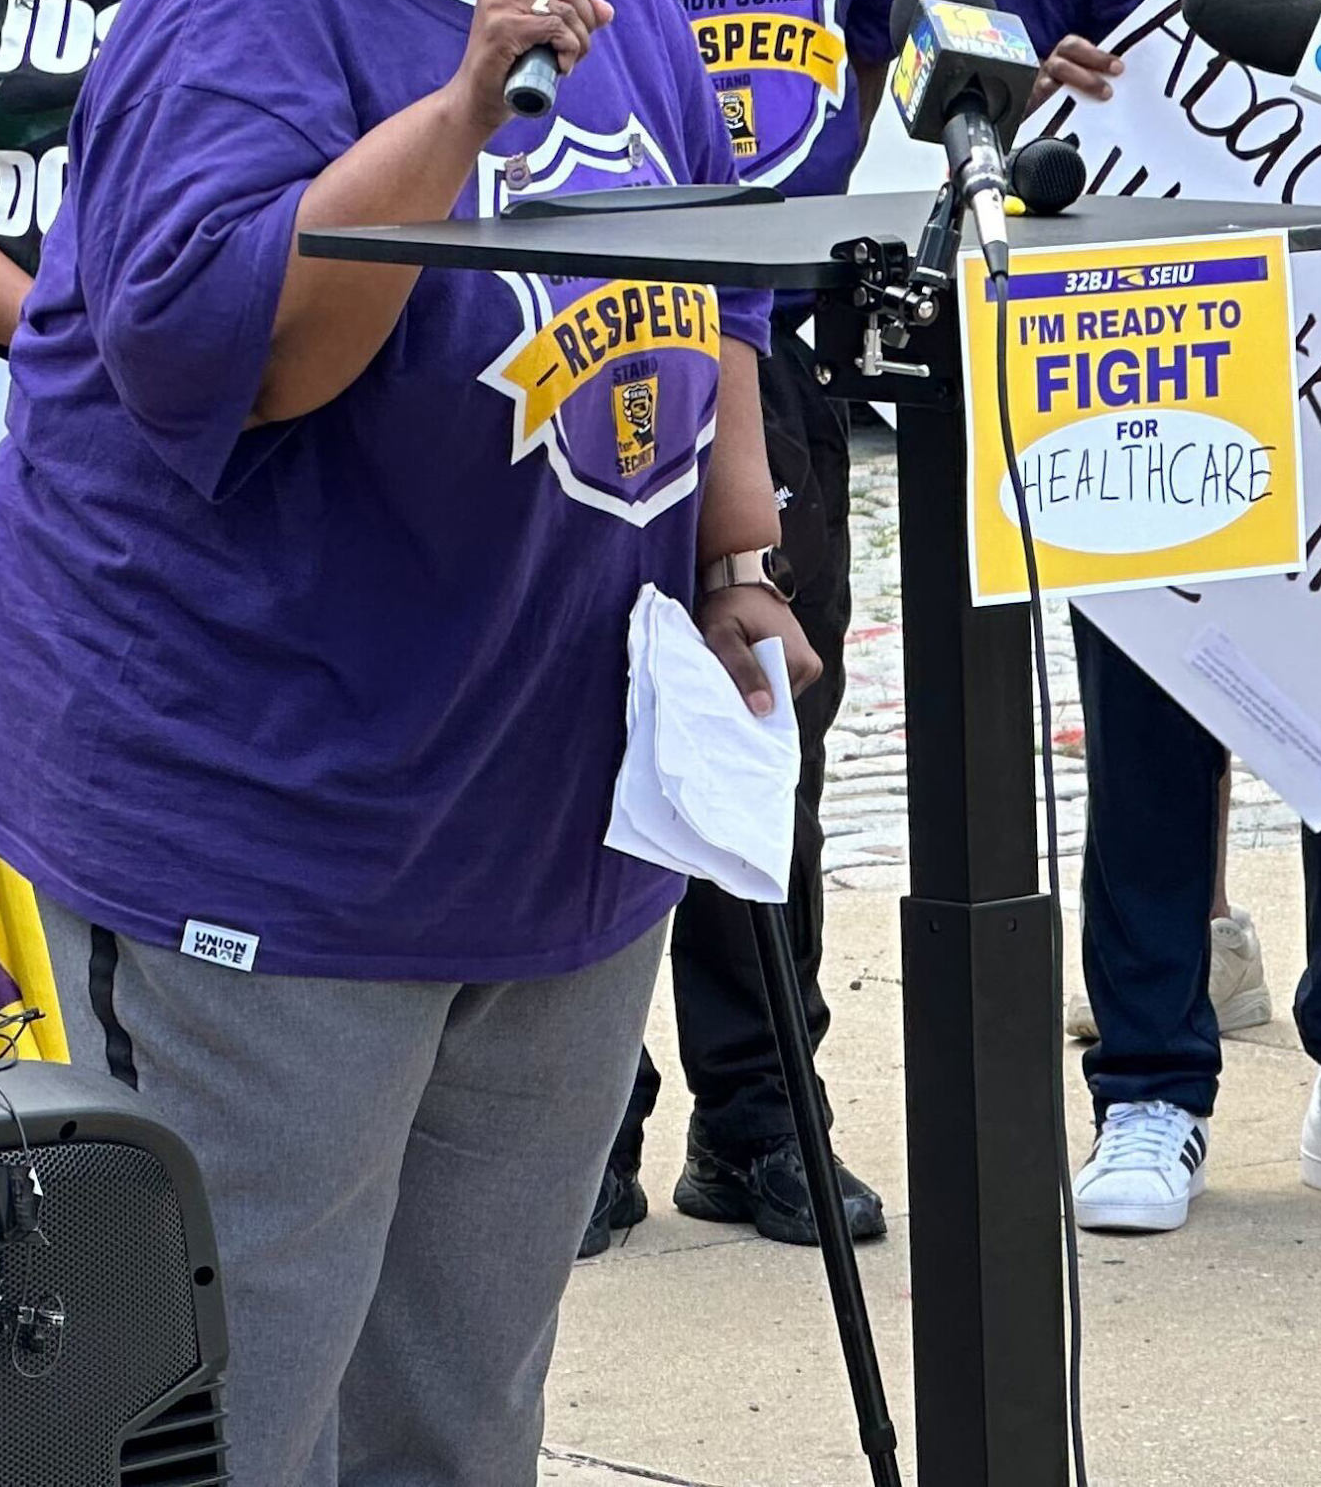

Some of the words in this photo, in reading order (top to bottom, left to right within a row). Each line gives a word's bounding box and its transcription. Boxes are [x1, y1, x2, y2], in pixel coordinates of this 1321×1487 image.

[698, 22, 815, 66] SPECT
[1065, 270, 1114, 293] 32BJ
[1148, 264, 1195, 286] SEIU
[1019, 313, 1066, 346] I'M
[1077, 303, 1187, 341] READY
[1197, 300, 1241, 331] TO
[612, 357, 658, 385] STAND
[1036, 341, 1231, 413] FIGHT
[1116, 419, 1159, 441] FOR
[1021, 442, 1277, 513] HEALTHCARE
[195, 931, 247, 953] UNION
